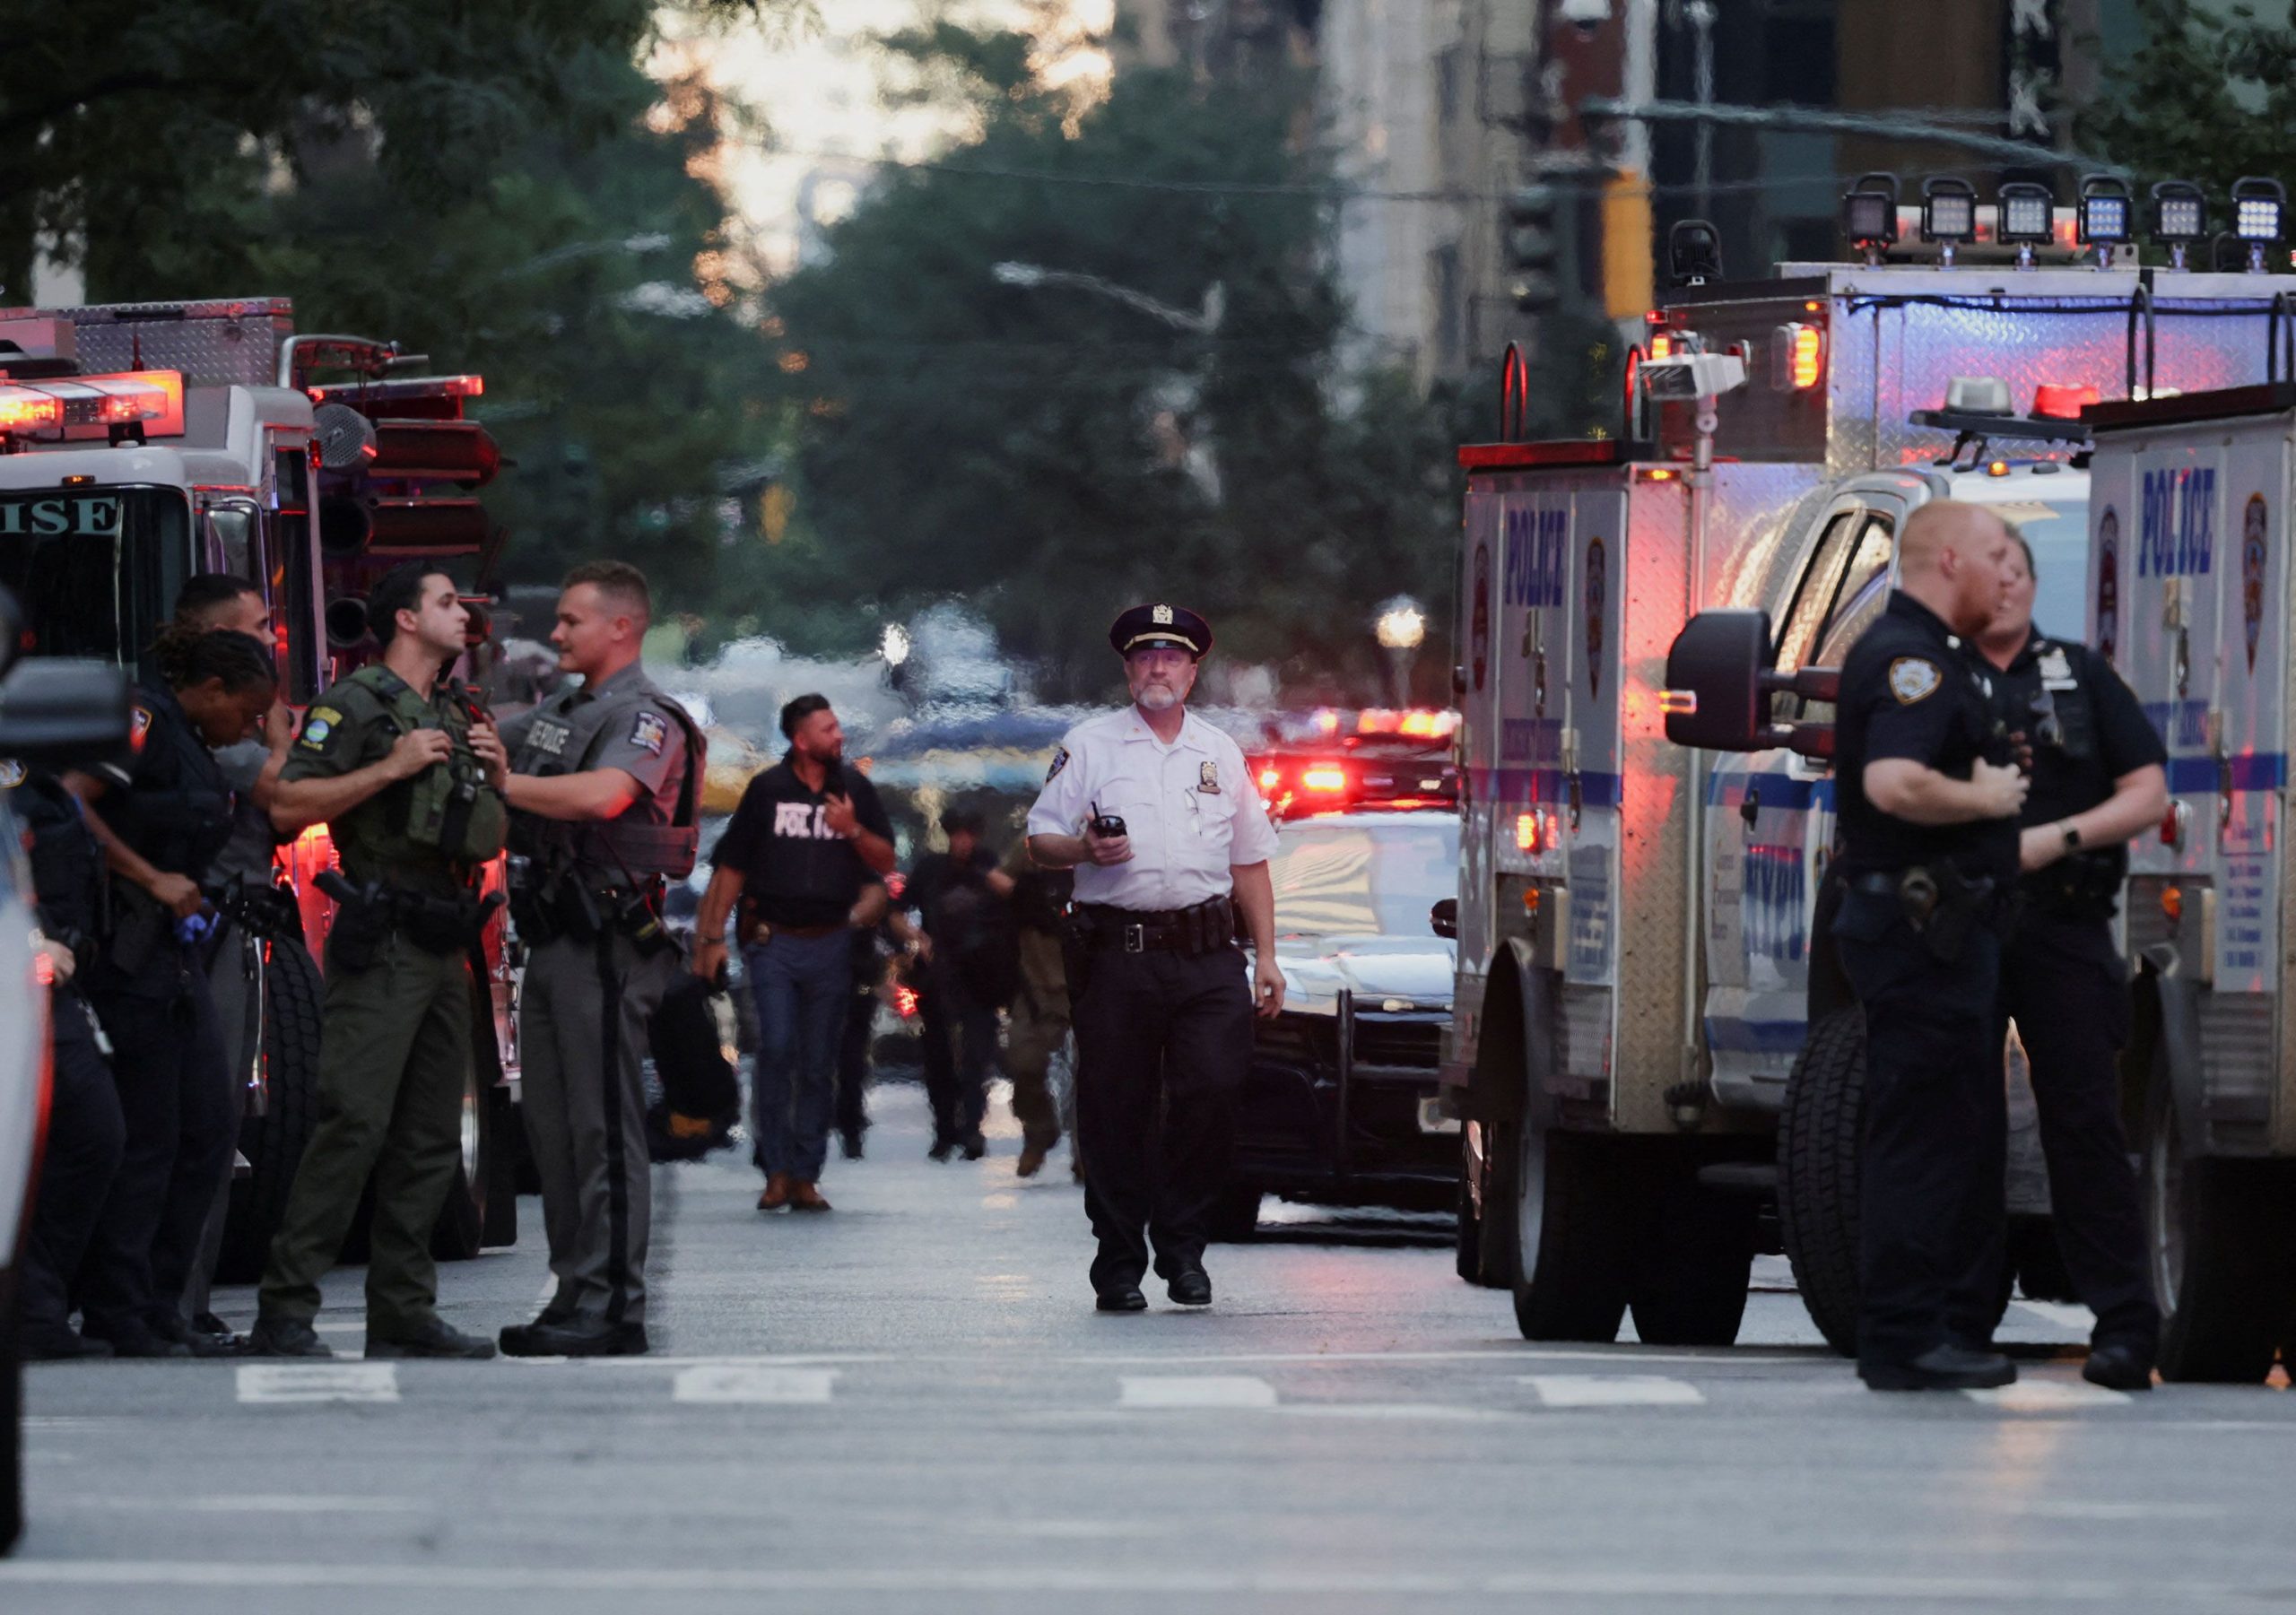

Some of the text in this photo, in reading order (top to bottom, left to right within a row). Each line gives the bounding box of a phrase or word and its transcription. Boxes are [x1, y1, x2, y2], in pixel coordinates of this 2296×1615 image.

[0, 497, 121, 535] ISE
[2139, 467, 2214, 577] POLICE
[1506, 510, 1566, 607] POLICE
[774, 802, 846, 840] POLI
